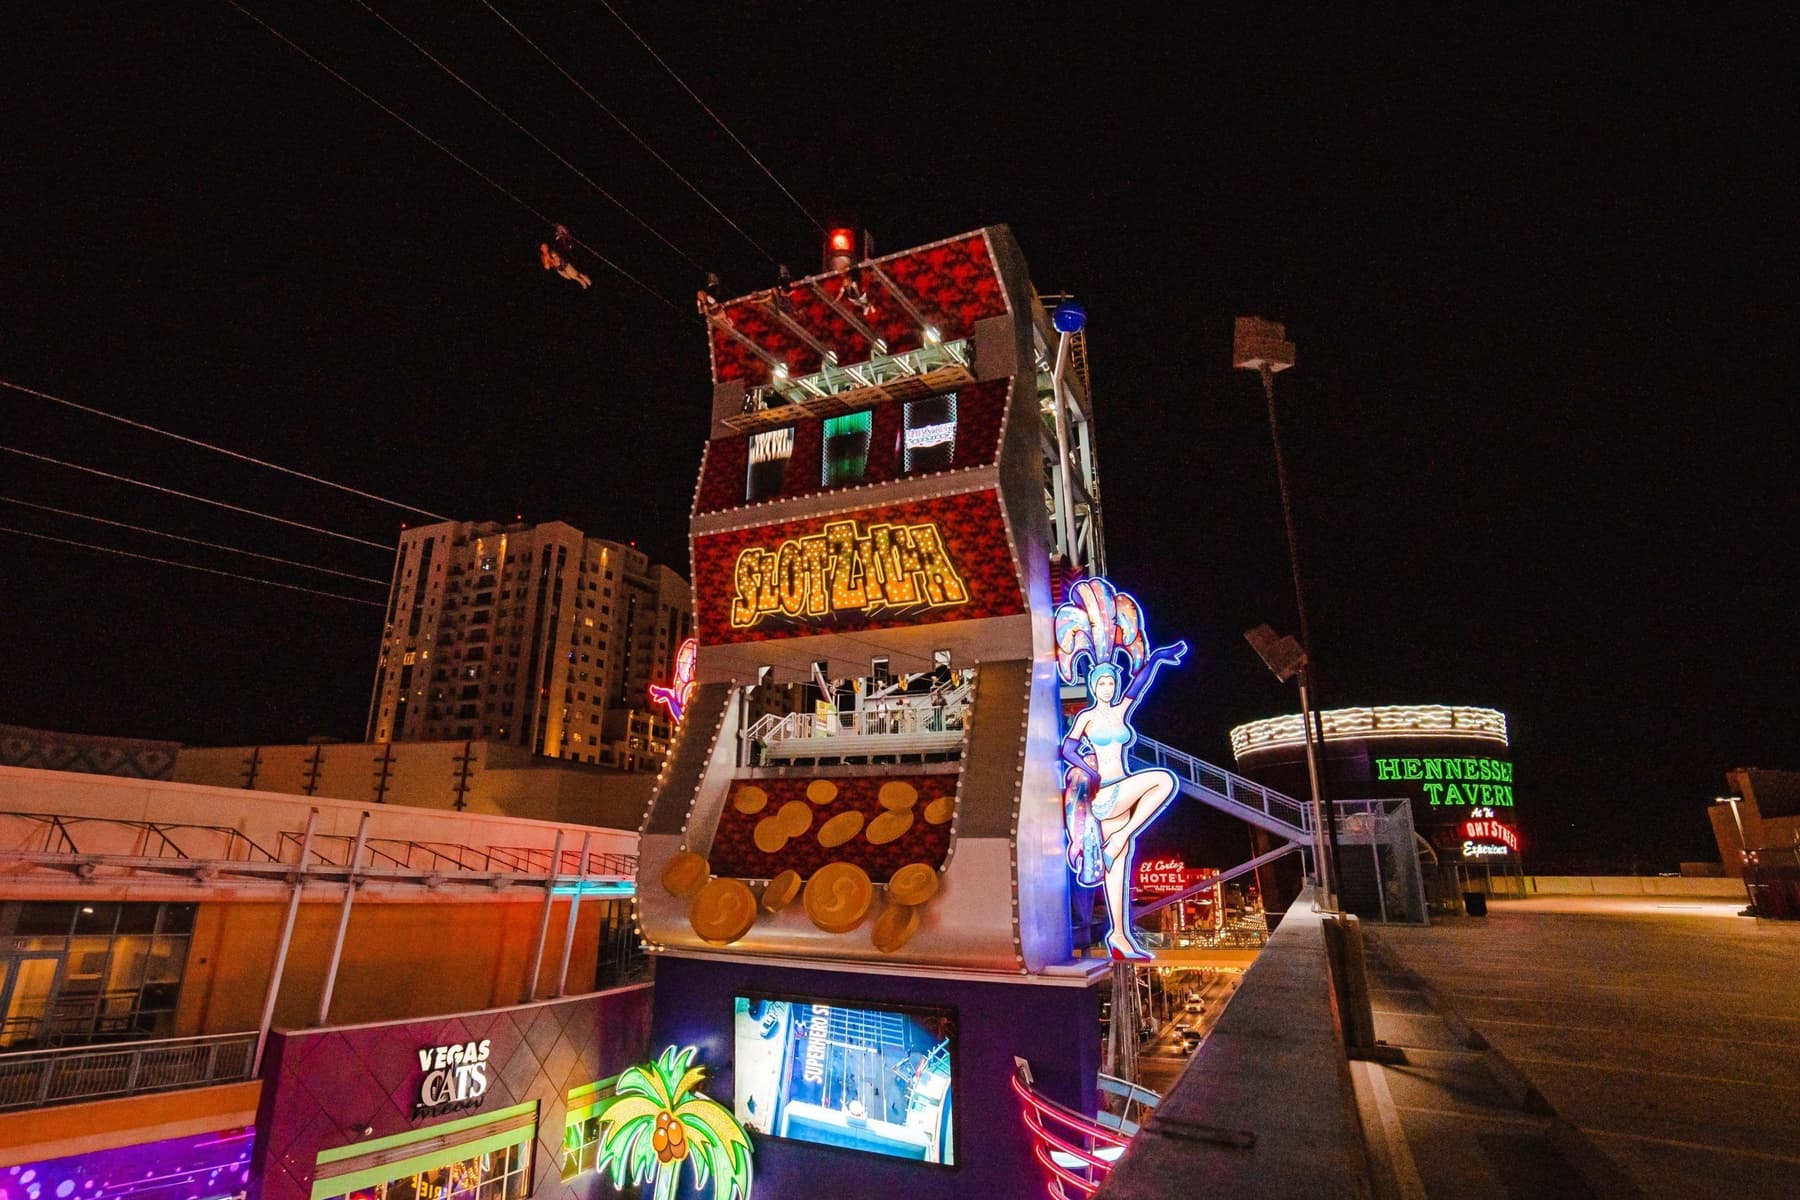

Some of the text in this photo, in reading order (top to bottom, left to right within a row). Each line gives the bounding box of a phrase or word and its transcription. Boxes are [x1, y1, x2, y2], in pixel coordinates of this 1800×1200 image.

[732, 520, 968, 627] SLOTZILLA
[1423, 783, 1513, 806] TAVERN
[1140, 859, 1184, 872] El Cortez
[1140, 873, 1185, 883] HOTEL
[418, 1040, 491, 1071] VEGAS
[804, 1017, 828, 1084] SUPERHERO
[421, 1062, 487, 1106] CATS
